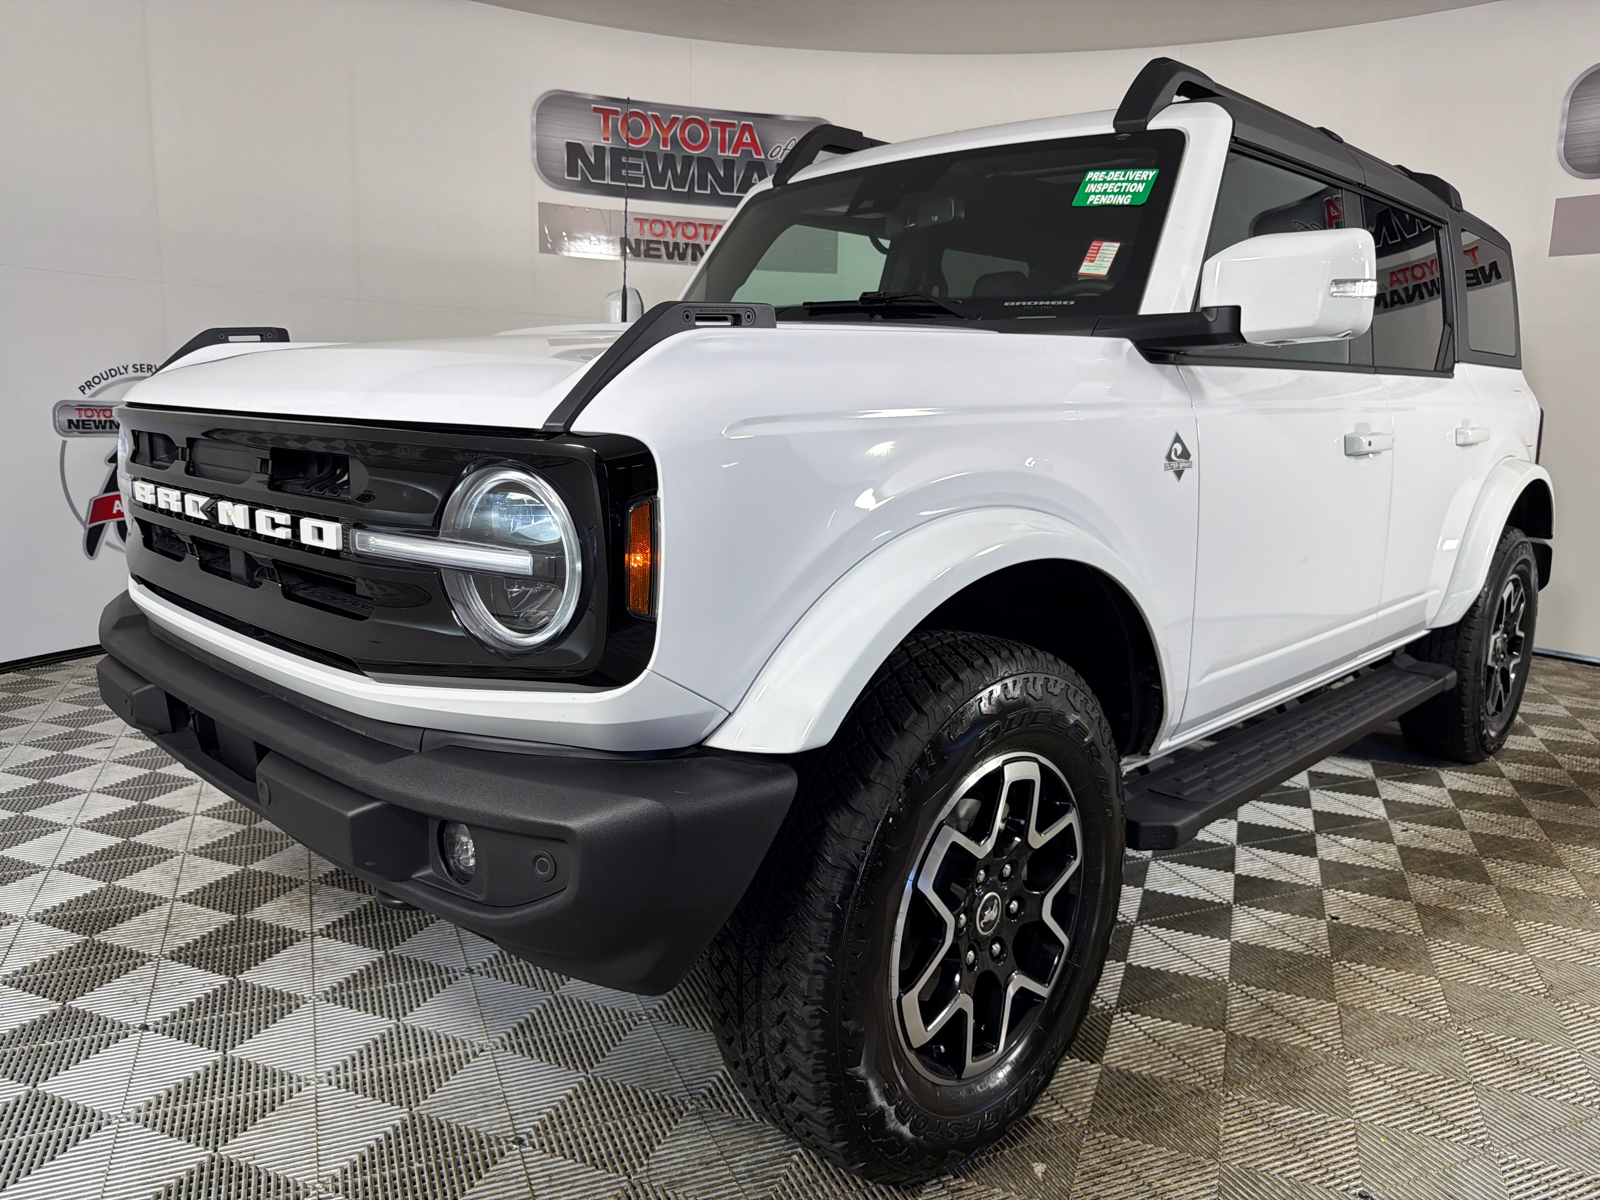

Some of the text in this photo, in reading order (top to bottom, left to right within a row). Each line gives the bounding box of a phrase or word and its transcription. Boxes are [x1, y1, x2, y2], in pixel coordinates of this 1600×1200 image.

[592, 105, 798, 161] TOYOTA of
[565, 141, 783, 197] NEWNA
[1085, 170, 1156, 181] PRE-DELIVERY
[1085, 182, 1146, 193] INSPECTION
[1086, 194, 1132, 205] PENDING
[78, 364, 129, 395] PROUDLY
[133, 480, 343, 551] BRONCO
